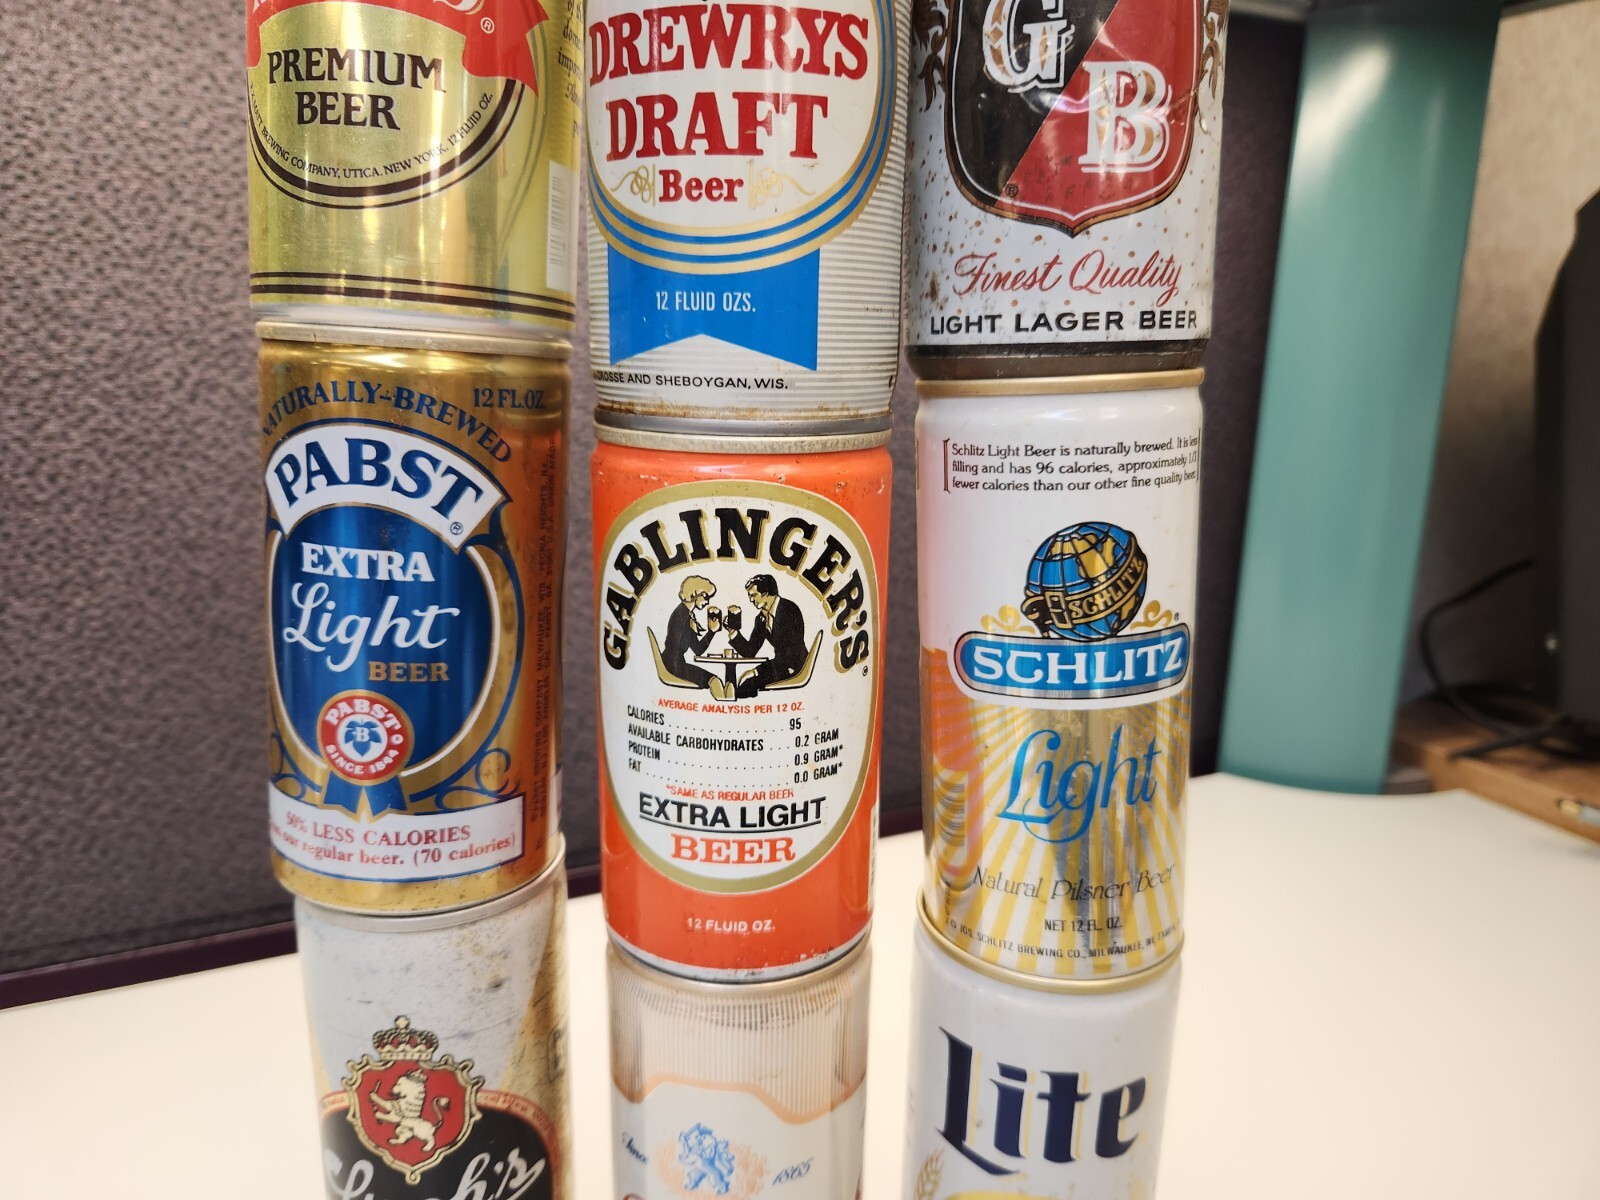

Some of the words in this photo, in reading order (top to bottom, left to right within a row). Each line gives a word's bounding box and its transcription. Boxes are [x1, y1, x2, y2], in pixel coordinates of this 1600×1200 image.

[589, 3, 868, 87] DREWRYS
[267, 47, 446, 93] PREMIUM
[295, 91, 401, 130] BEER
[1077, 61, 1173, 173] B
[261, 126, 290, 161] BREWING
[291, 156, 341, 179] COMPANY,
[383, 159, 412, 175] NEW
[447, 134, 459, 146] 12
[456, 110, 482, 139] FLUID
[479, 92, 493, 110] OZ.
[606, 91, 828, 162] DRAFT
[659, 169, 744, 202] Beer
[952, 252, 1070, 296] Finest
[1068, 249, 1181, 307] Quality
[655, 291, 669, 311] 12
[675, 291, 716, 312] FLUID
[722, 291, 757, 313] OZS.
[930, 314, 1002, 335] LIGHT
[1014, 311, 1124, 333] LAGER
[1138, 310, 1198, 330] BEER
[627, 373, 651, 385] AND
[655, 375, 751, 390] SHEBOYGAN,
[754, 378, 789, 390] WIS.
[473, 387, 494, 408] 12
[951, 443, 985, 457] Schlitz
[987, 444, 1020, 460] Light
[1024, 444, 1056, 457] Beer
[1060, 445, 1071, 456] is
[1074, 441, 1131, 457] naturally
[1134, 437, 1174, 453] brewed.
[1176, 437, 1182, 449] It
[1183, 437, 1189, 448] is
[273, 437, 484, 521] PABST
[952, 460, 978, 475] filling
[981, 462, 1004, 474] and
[1009, 462, 1032, 474] has
[1036, 462, 1054, 474] 96
[1058, 461, 1113, 474] calories,
[1118, 454, 1187, 474] approximately
[952, 476, 980, 488] fewer
[982, 479, 1029, 491] calories
[1033, 479, 1063, 491] than
[1067, 481, 1091, 491] our
[1094, 477, 1128, 490] other
[1131, 476, 1151, 488] fine
[1154, 471, 1183, 488] quality
[301, 542, 436, 582] EXTRA
[603, 508, 870, 673] GABLINGER'S
[1070, 557, 1144, 618] SCHLITZ
[283, 582, 461, 672] Light
[368, 661, 450, 682] BEER
[973, 635, 1184, 685] SCHLITZ
[325, 698, 402, 730] PABST
[627, 705, 665, 726] CALORIES
[789, 718, 802, 730] 95
[658, 698, 698, 712] AVERAGE
[702, 704, 750, 714] ANALYSIS
[754, 704, 772, 713] PER
[776, 703, 787, 713] 12
[790, 701, 805, 711] OZ.
[355, 727, 370, 742] B
[627, 723, 671, 745] AVAILABLE
[676, 735, 764, 752] CARBOHYDRATES
[795, 735, 809, 748] 0.2
[814, 728, 839, 745] GRAM
[325, 744, 366, 775] SINCE
[628, 741, 660, 761] PROTEIN
[794, 752, 809, 766] 0.9
[628, 757, 641, 773] FAT
[794, 770, 808, 784] 0.0
[996, 722, 1162, 844] Light
[639, 791, 730, 827] EXTRA
[740, 796, 827, 827] LIGHT
[701, 790, 715, 800] AS
[718, 790, 766, 802] REGULAR
[769, 789, 794, 799] BEER
[302, 840, 354, 863] regular
[360, 848, 405, 865] beer.
[413, 848, 442, 867] (70
[448, 831, 516, 860] calories)
[312, 822, 354, 844] LESS
[363, 825, 471, 846] CALORIES
[670, 833, 796, 865] BEER
[973, 865, 1040, 899] Natural
[1051, 878, 1131, 900] Pilsner
[1135, 863, 1175, 896] Beer
[687, 917, 702, 928] 12
[705, 919, 748, 932] FLUID
[752, 919, 776, 931] OZ.
[1044, 919, 1066, 931] NET
[1071, 920, 1083, 932] 12
[976, 931, 1014, 951] SCHLITZ
[1017, 943, 1063, 958] BREWING
[935, 1025, 1147, 1177] Lite
[771, 1157, 815, 1186] 1865
